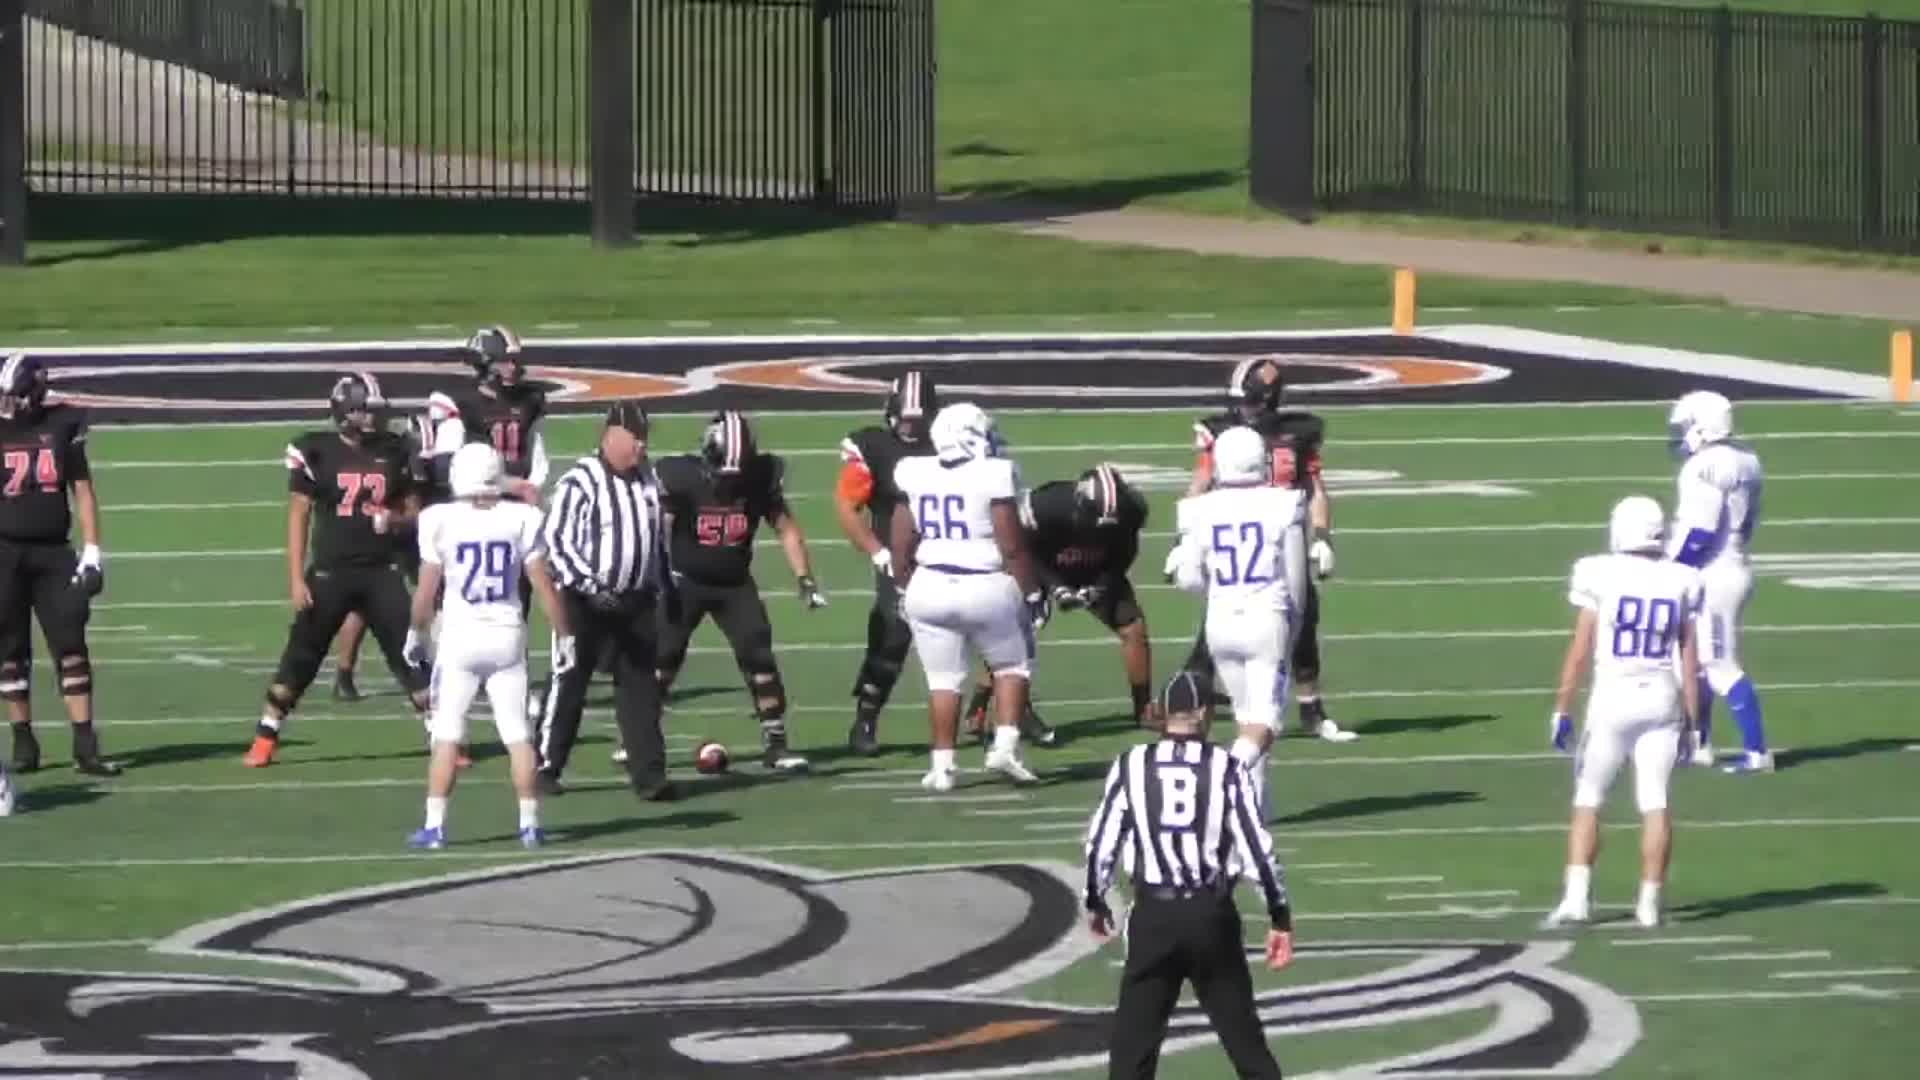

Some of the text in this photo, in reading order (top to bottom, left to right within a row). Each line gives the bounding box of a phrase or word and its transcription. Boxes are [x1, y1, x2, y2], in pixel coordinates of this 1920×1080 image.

[3, 449, 58, 496] 74
[336, 472, 387, 517] 73
[919, 494, 969, 540] 66
[456, 541, 512, 604] 29
[1212, 521, 1271, 586] 52
[1612, 595, 1678, 659] 80
[1158, 767, 1198, 827] B
